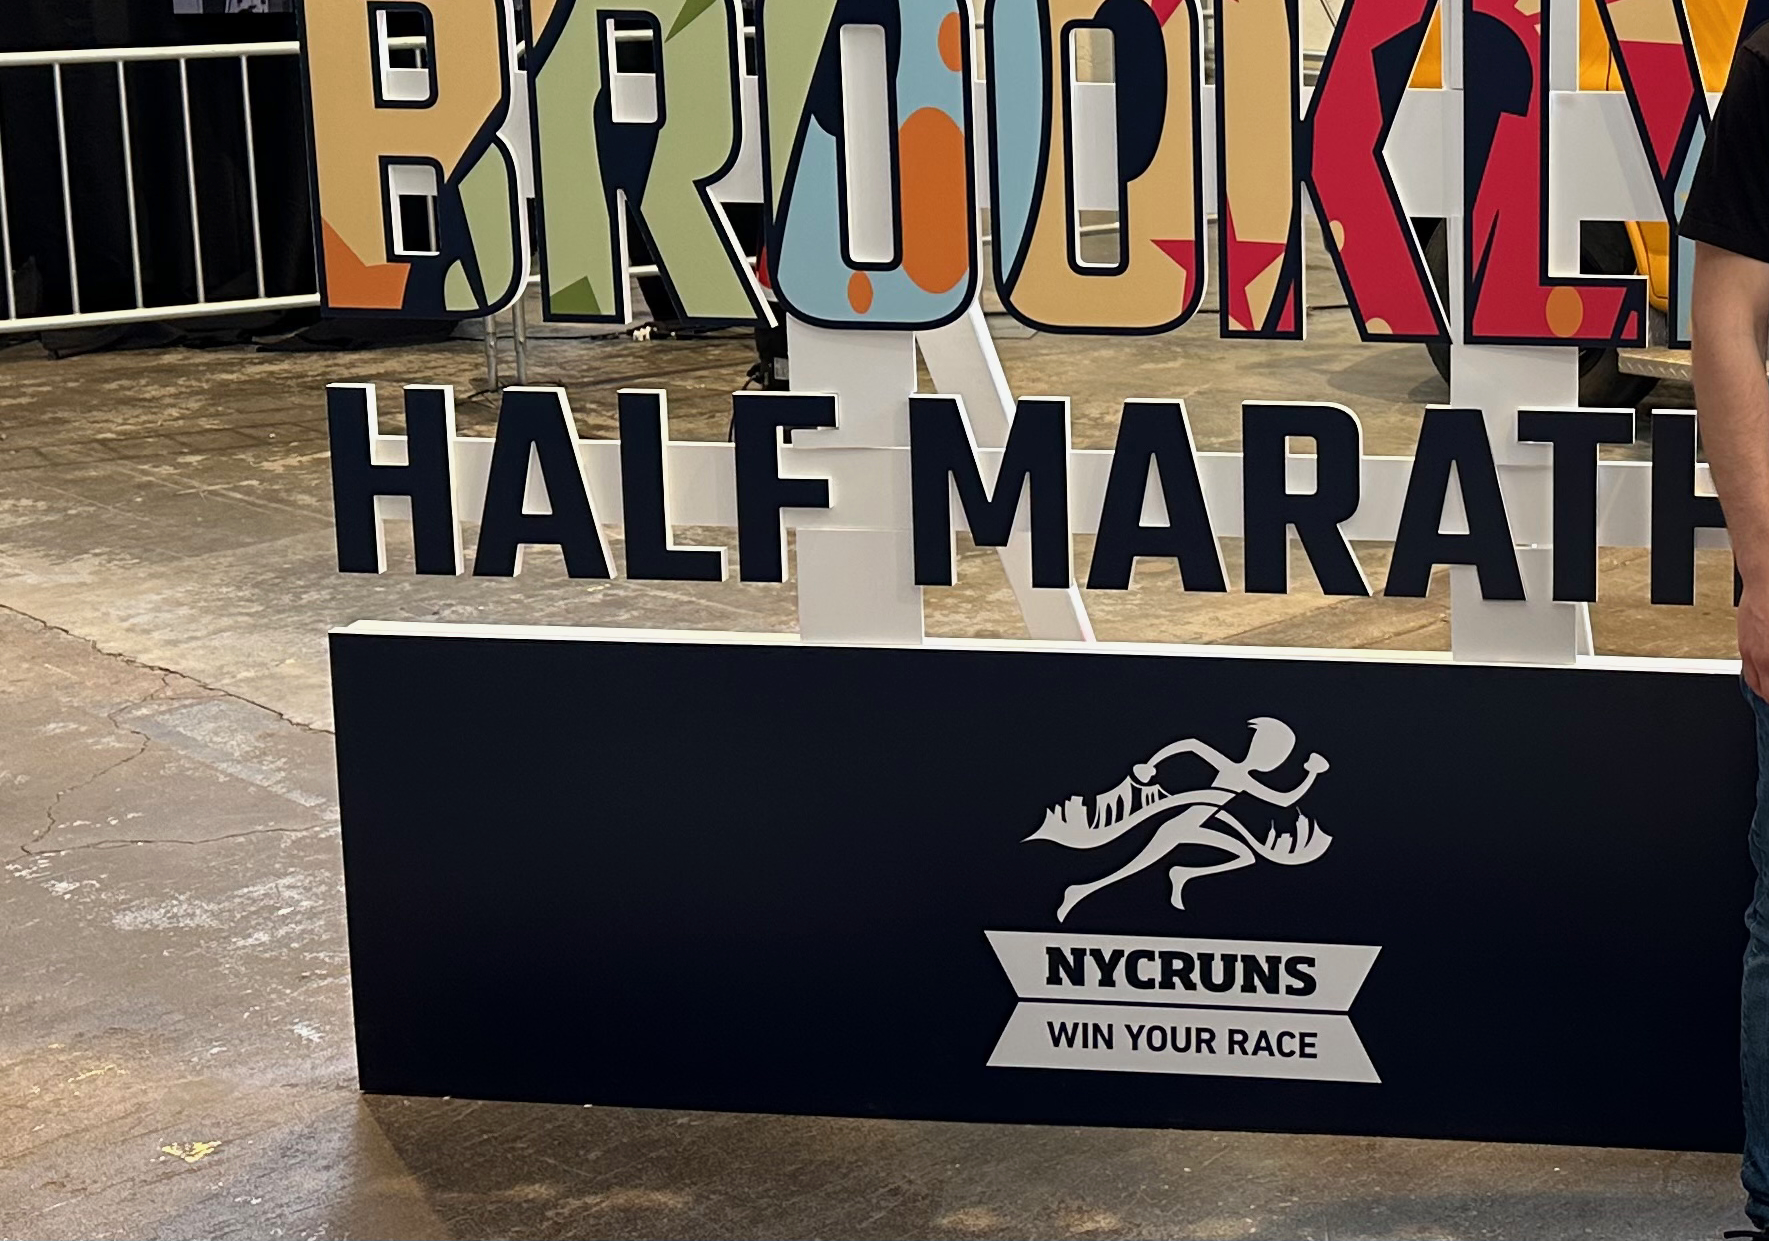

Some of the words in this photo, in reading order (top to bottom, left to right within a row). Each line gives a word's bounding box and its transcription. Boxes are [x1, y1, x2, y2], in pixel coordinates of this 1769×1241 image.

[326, 385, 838, 583] HALF
[1045, 946, 1317, 997] NYCRUNS
[1046, 1021, 1114, 1050] WIN
[1124, 1024, 1217, 1055] YOUR
[1227, 1028, 1318, 1059] RACE
